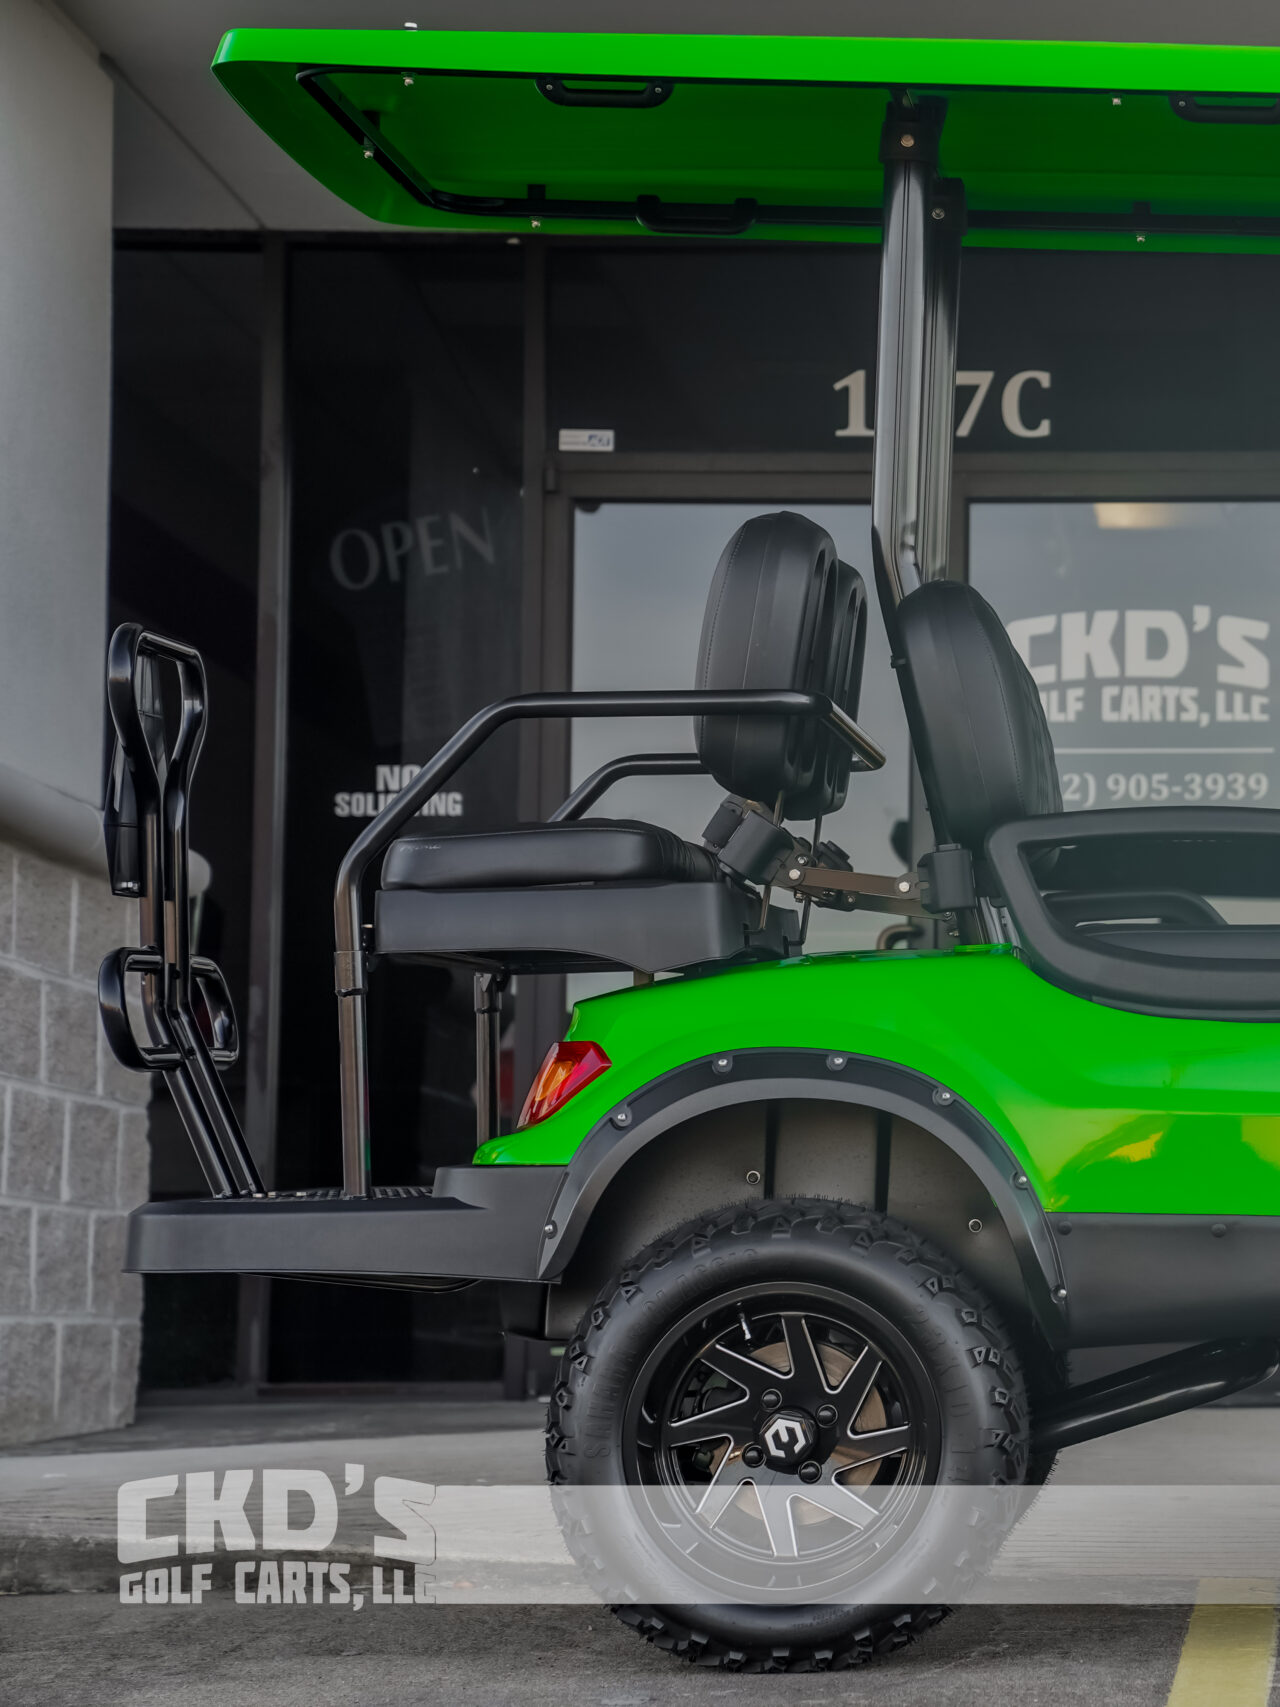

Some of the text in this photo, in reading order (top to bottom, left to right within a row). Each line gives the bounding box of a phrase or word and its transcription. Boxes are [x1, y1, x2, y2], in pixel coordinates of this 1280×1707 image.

[833, 369, 1051, 438] 17C
[330, 506, 495, 590] OPEN
[1006, 605, 1270, 690] CKD'S
[1038, 687, 1085, 722] LF
[334, 792, 463, 817] SOLIING
[1106, 772, 1269, 801] 905-3939
